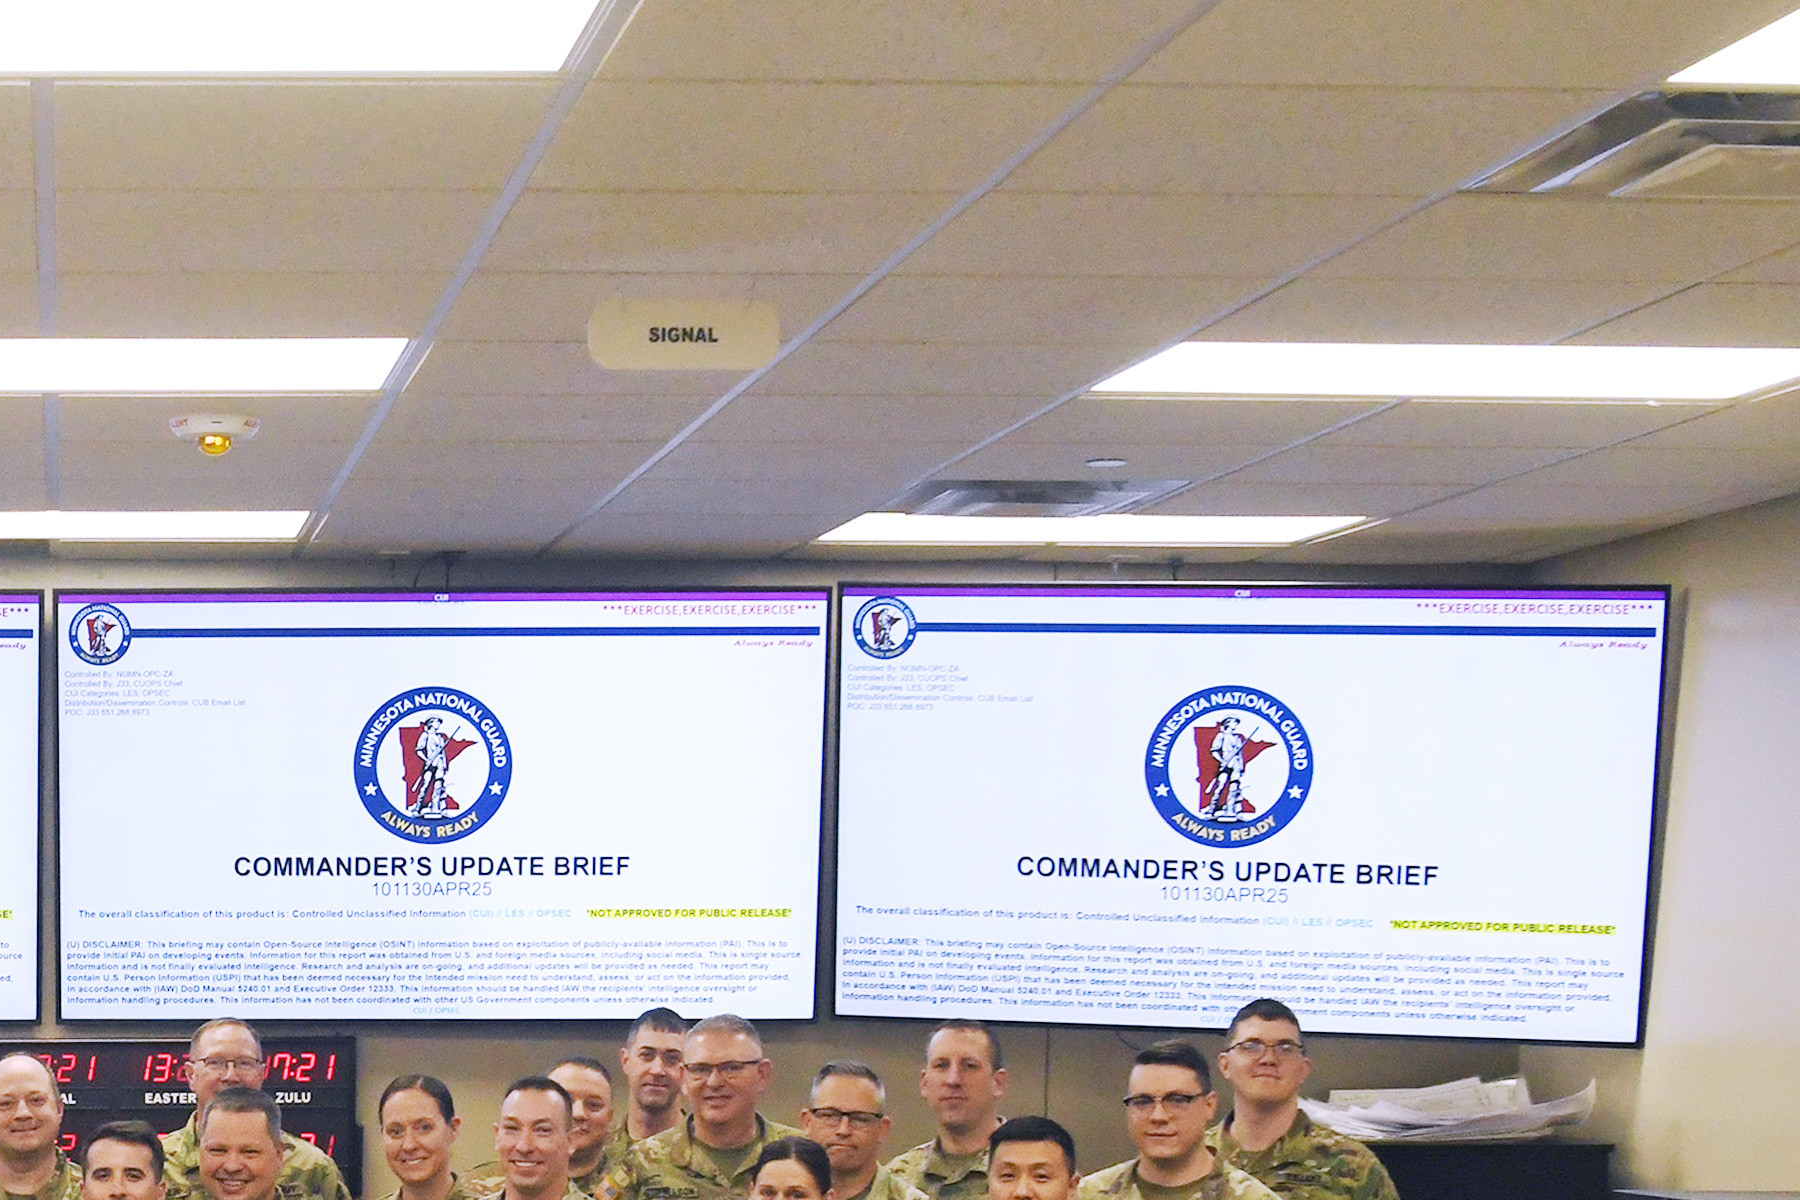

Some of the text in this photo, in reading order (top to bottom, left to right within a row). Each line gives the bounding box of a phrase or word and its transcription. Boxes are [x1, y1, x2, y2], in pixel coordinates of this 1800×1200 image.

[649, 327, 718, 342] SIGNAL
[734, 640, 814, 648] Always Ready
[1560, 641, 1648, 650] Always Ready
[360, 692, 506, 768] MINNESOTA NATIONAL GUARD
[1150, 692, 1308, 770] MINNESOTA NATIONAL GUARD
[380, 810, 479, 838] ALWAYS READY
[1172, 812, 1276, 841] ALWAYS READY
[442, 856, 543, 876] UPDATE
[554, 856, 630, 876] BRIEF
[1235, 861, 1345, 883] UPDATE
[1356, 864, 1438, 885] BRIEF
[372, 881, 492, 896] 101130APR25
[1161, 885, 1288, 903] 101130APR25
[615, 909, 672, 918] APPROVED
[675, 909, 695, 918] FOR
[700, 909, 736, 918] PUBLIC
[1419, 920, 1482, 930] APPROVED
[1486, 922, 1509, 932] FOR
[1513, 923, 1554, 933] PUBLIC
[144, 1092, 197, 1105] EASTER
[275, 1092, 312, 1104] ZULU
